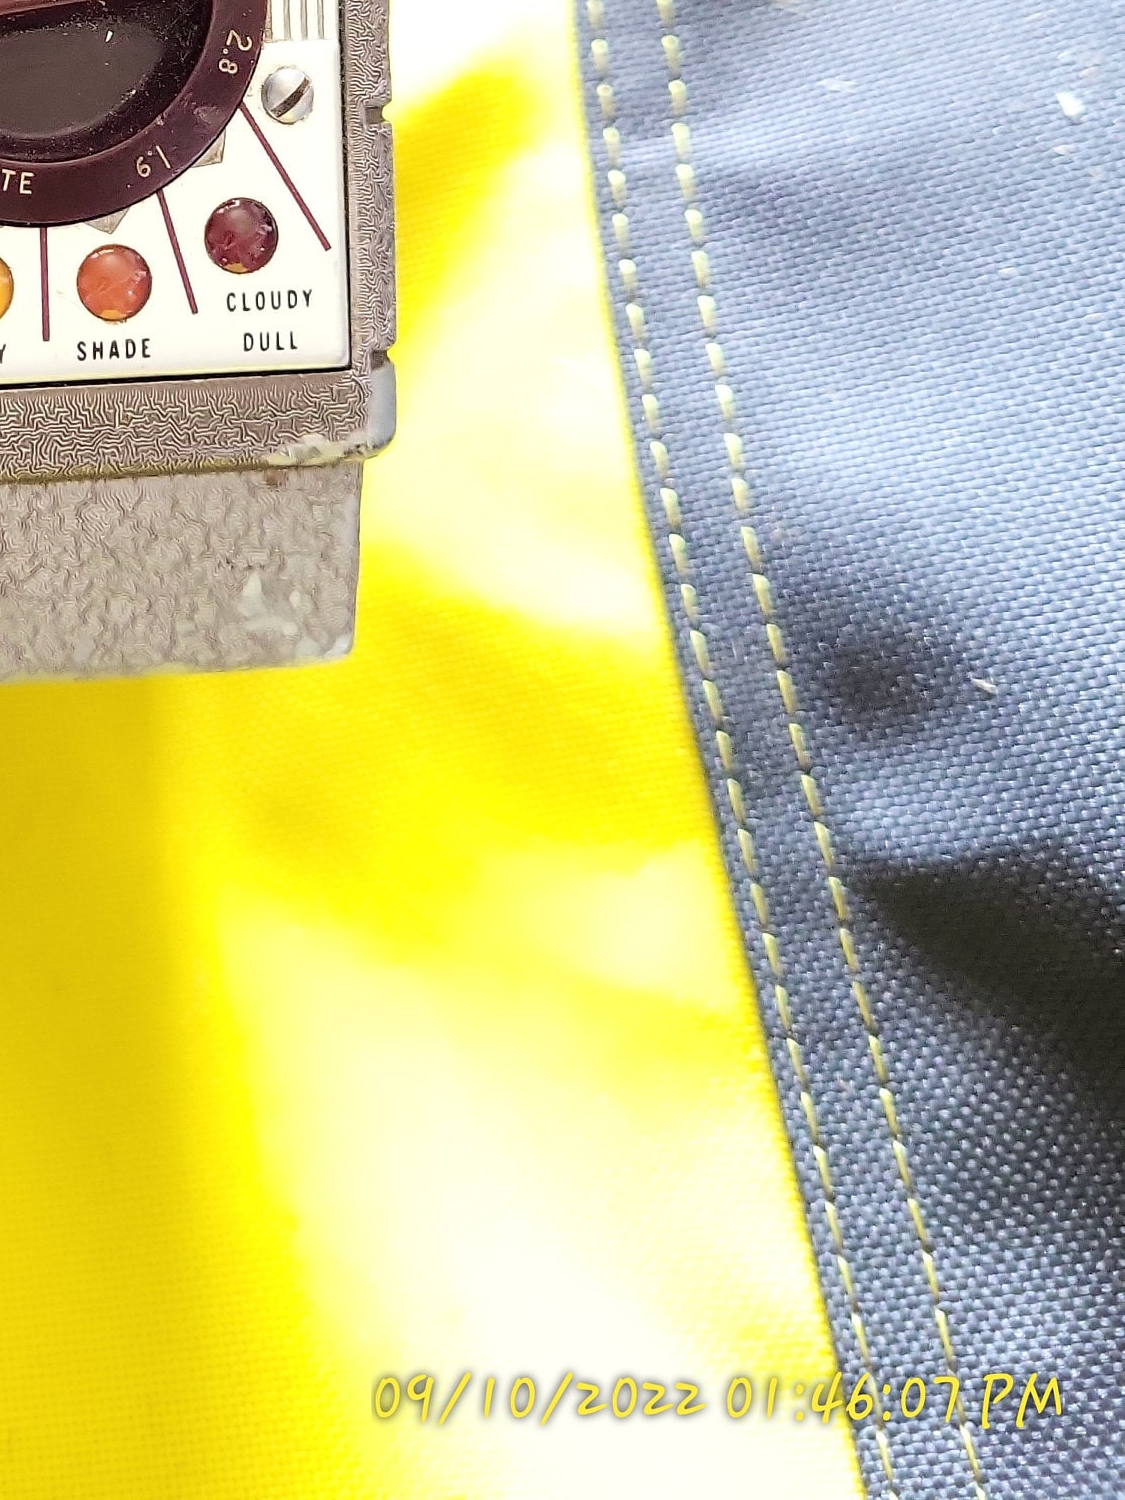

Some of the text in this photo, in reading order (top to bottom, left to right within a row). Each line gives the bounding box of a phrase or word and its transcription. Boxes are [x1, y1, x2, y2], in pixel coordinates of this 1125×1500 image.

[217, 28, 253, 75] 2.8
[226, 288, 313, 313] CLOUDY
[77, 337, 151, 362] SHADE
[242, 330, 298, 352] DULL
